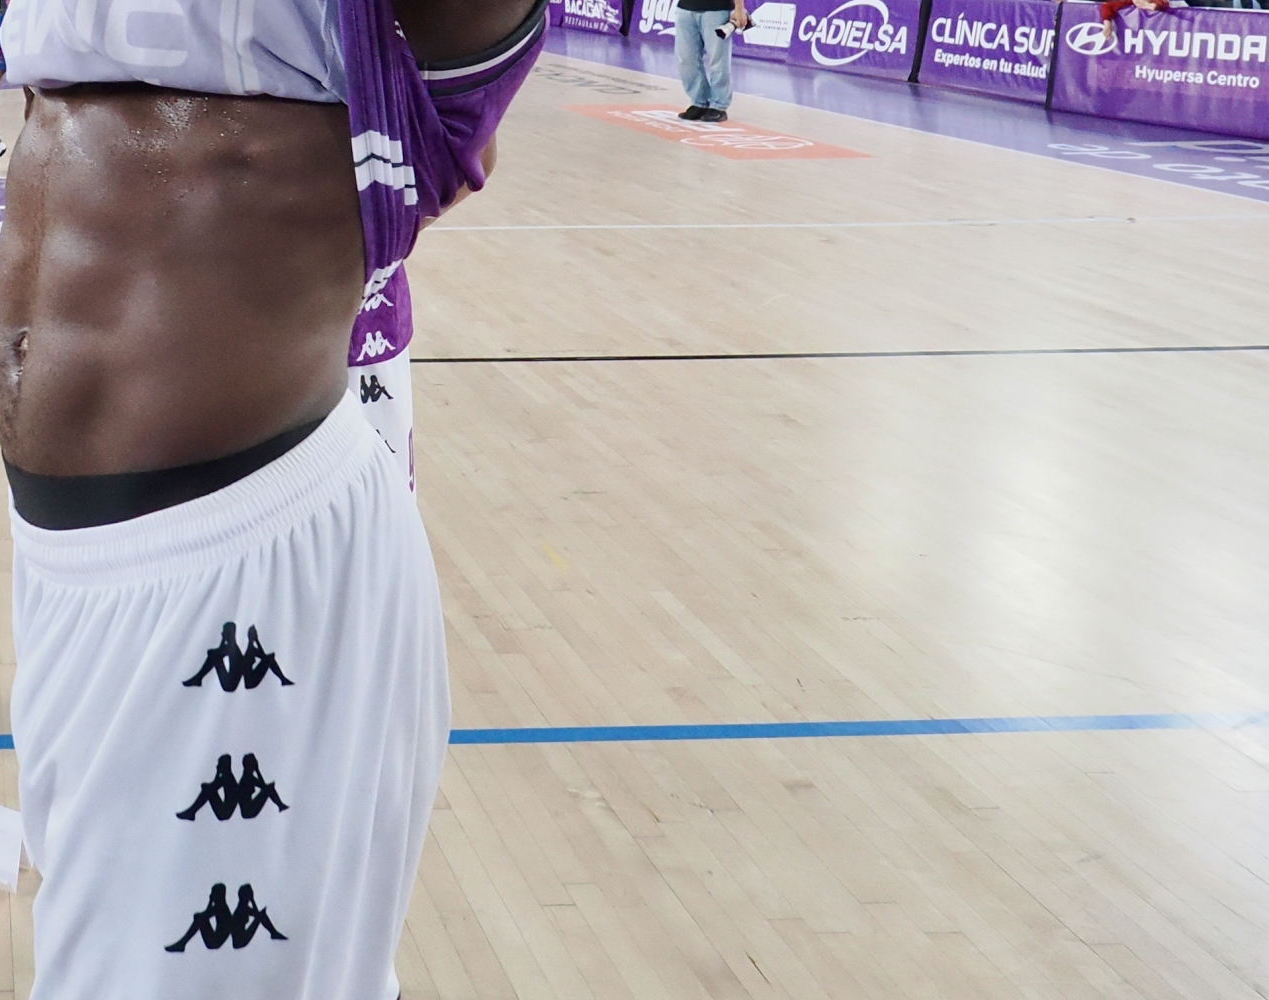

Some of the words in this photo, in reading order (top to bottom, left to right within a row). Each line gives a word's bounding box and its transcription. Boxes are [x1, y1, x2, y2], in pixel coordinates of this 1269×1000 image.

[798, 15, 908, 55] CADIELSA
[931, 12, 1010, 51] CLÍNICA
[1124, 28, 1268, 63] HYUNDA
[933, 49, 981, 69] Expertos
[982, 58, 997, 71] en
[999, 57, 1011, 72] tu
[1012, 61, 1047, 79] salud
[1135, 65, 1204, 83] Hyupersa
[1206, 70, 1260, 88] Centro
